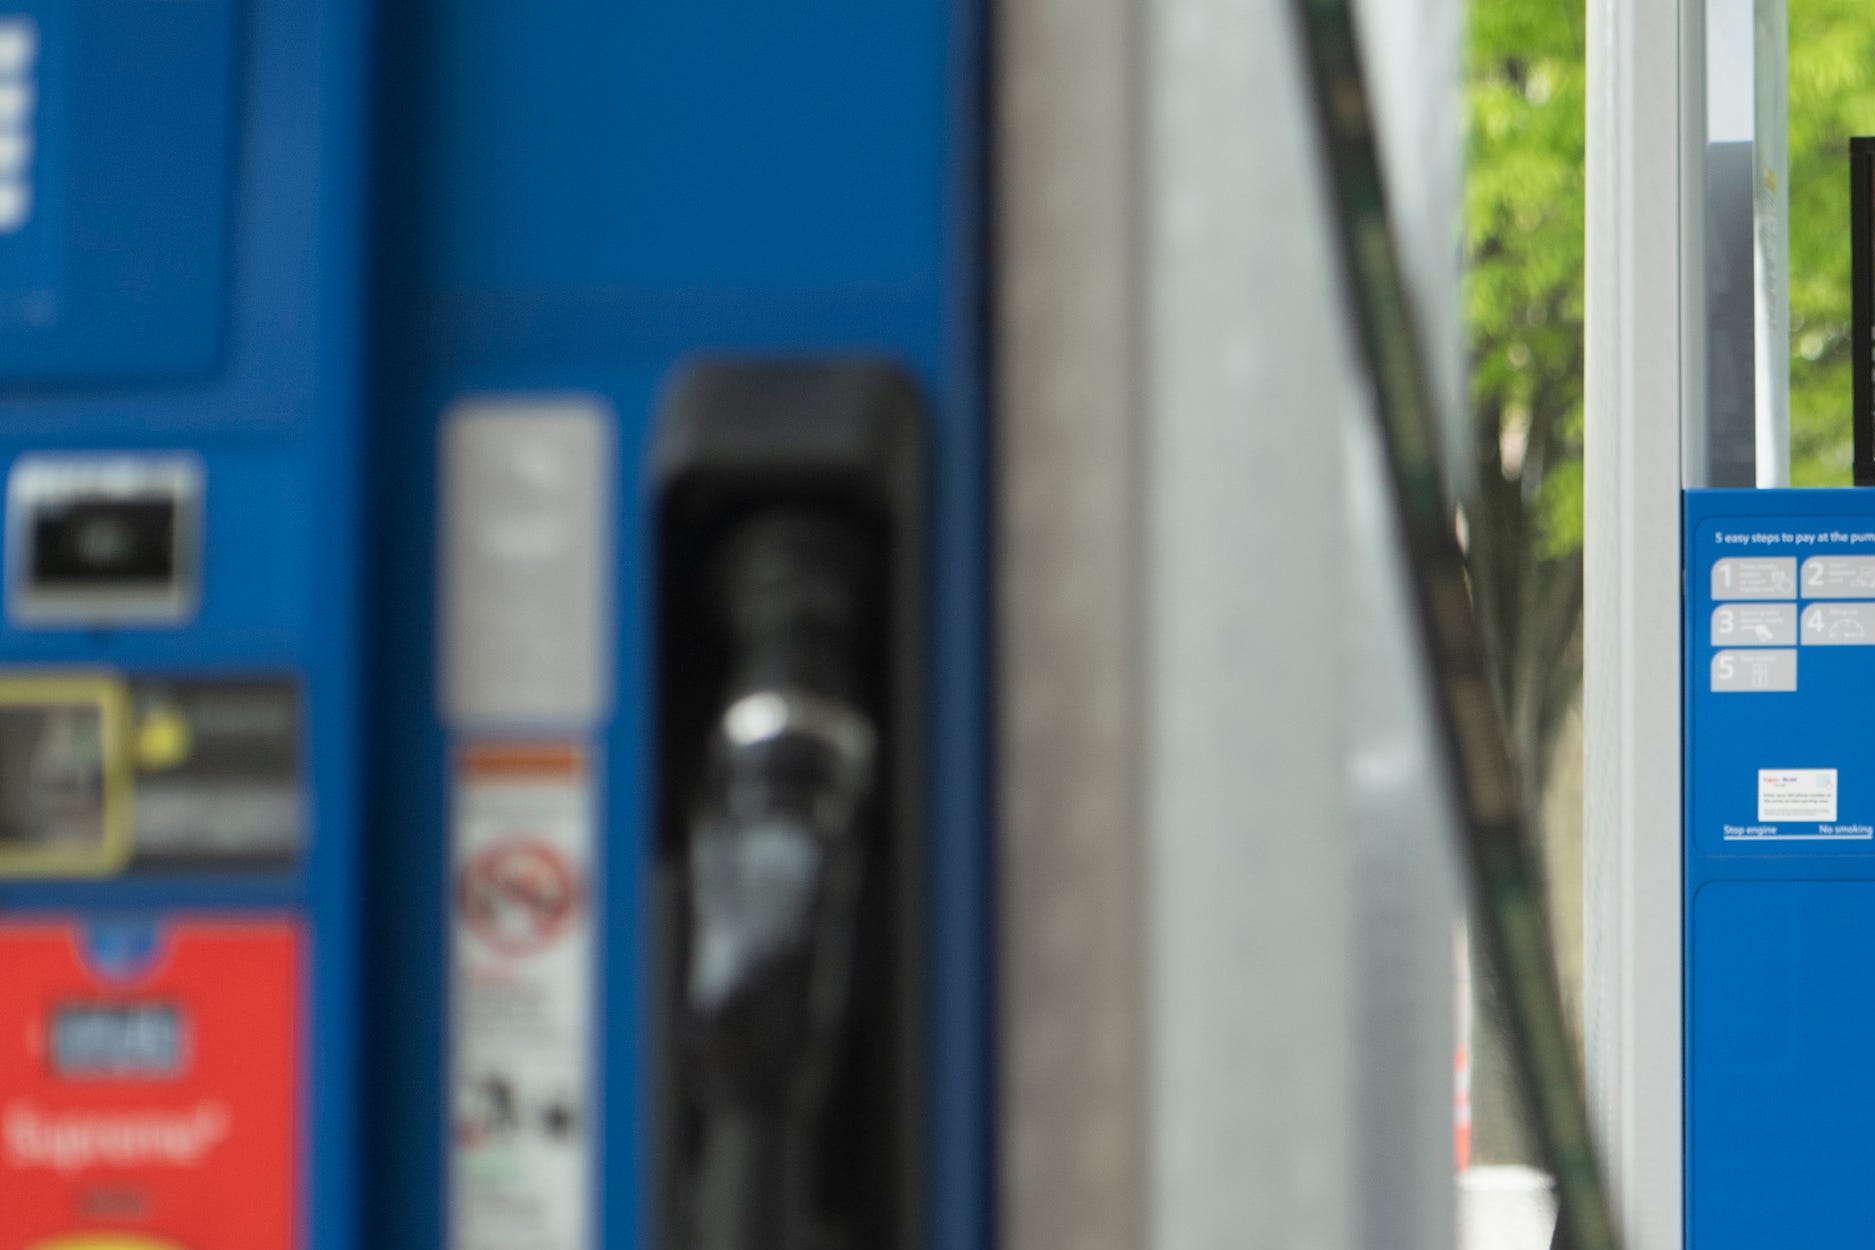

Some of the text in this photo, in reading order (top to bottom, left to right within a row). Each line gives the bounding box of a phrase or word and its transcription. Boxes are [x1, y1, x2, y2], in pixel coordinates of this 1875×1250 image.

[1715, 532, 1723, 543] 5
[1725, 534, 1750, 545] easy
[1750, 533, 1780, 545] steps
[1782, 533, 1793, 543] to
[1795, 533, 1815, 545] pay
[1817, 532, 1829, 543] at
[1830, 532, 1848, 543] the
[1718, 563, 1732, 588] 1
[1807, 562, 1825, 586] 2
[1718, 610, 1734, 634] 3
[1807, 610, 1825, 632] 4
[1718, 655, 1735, 680] 5
[1723, 825, 1777, 836] Stop engine
[1819, 824, 1874, 836] No smoking
